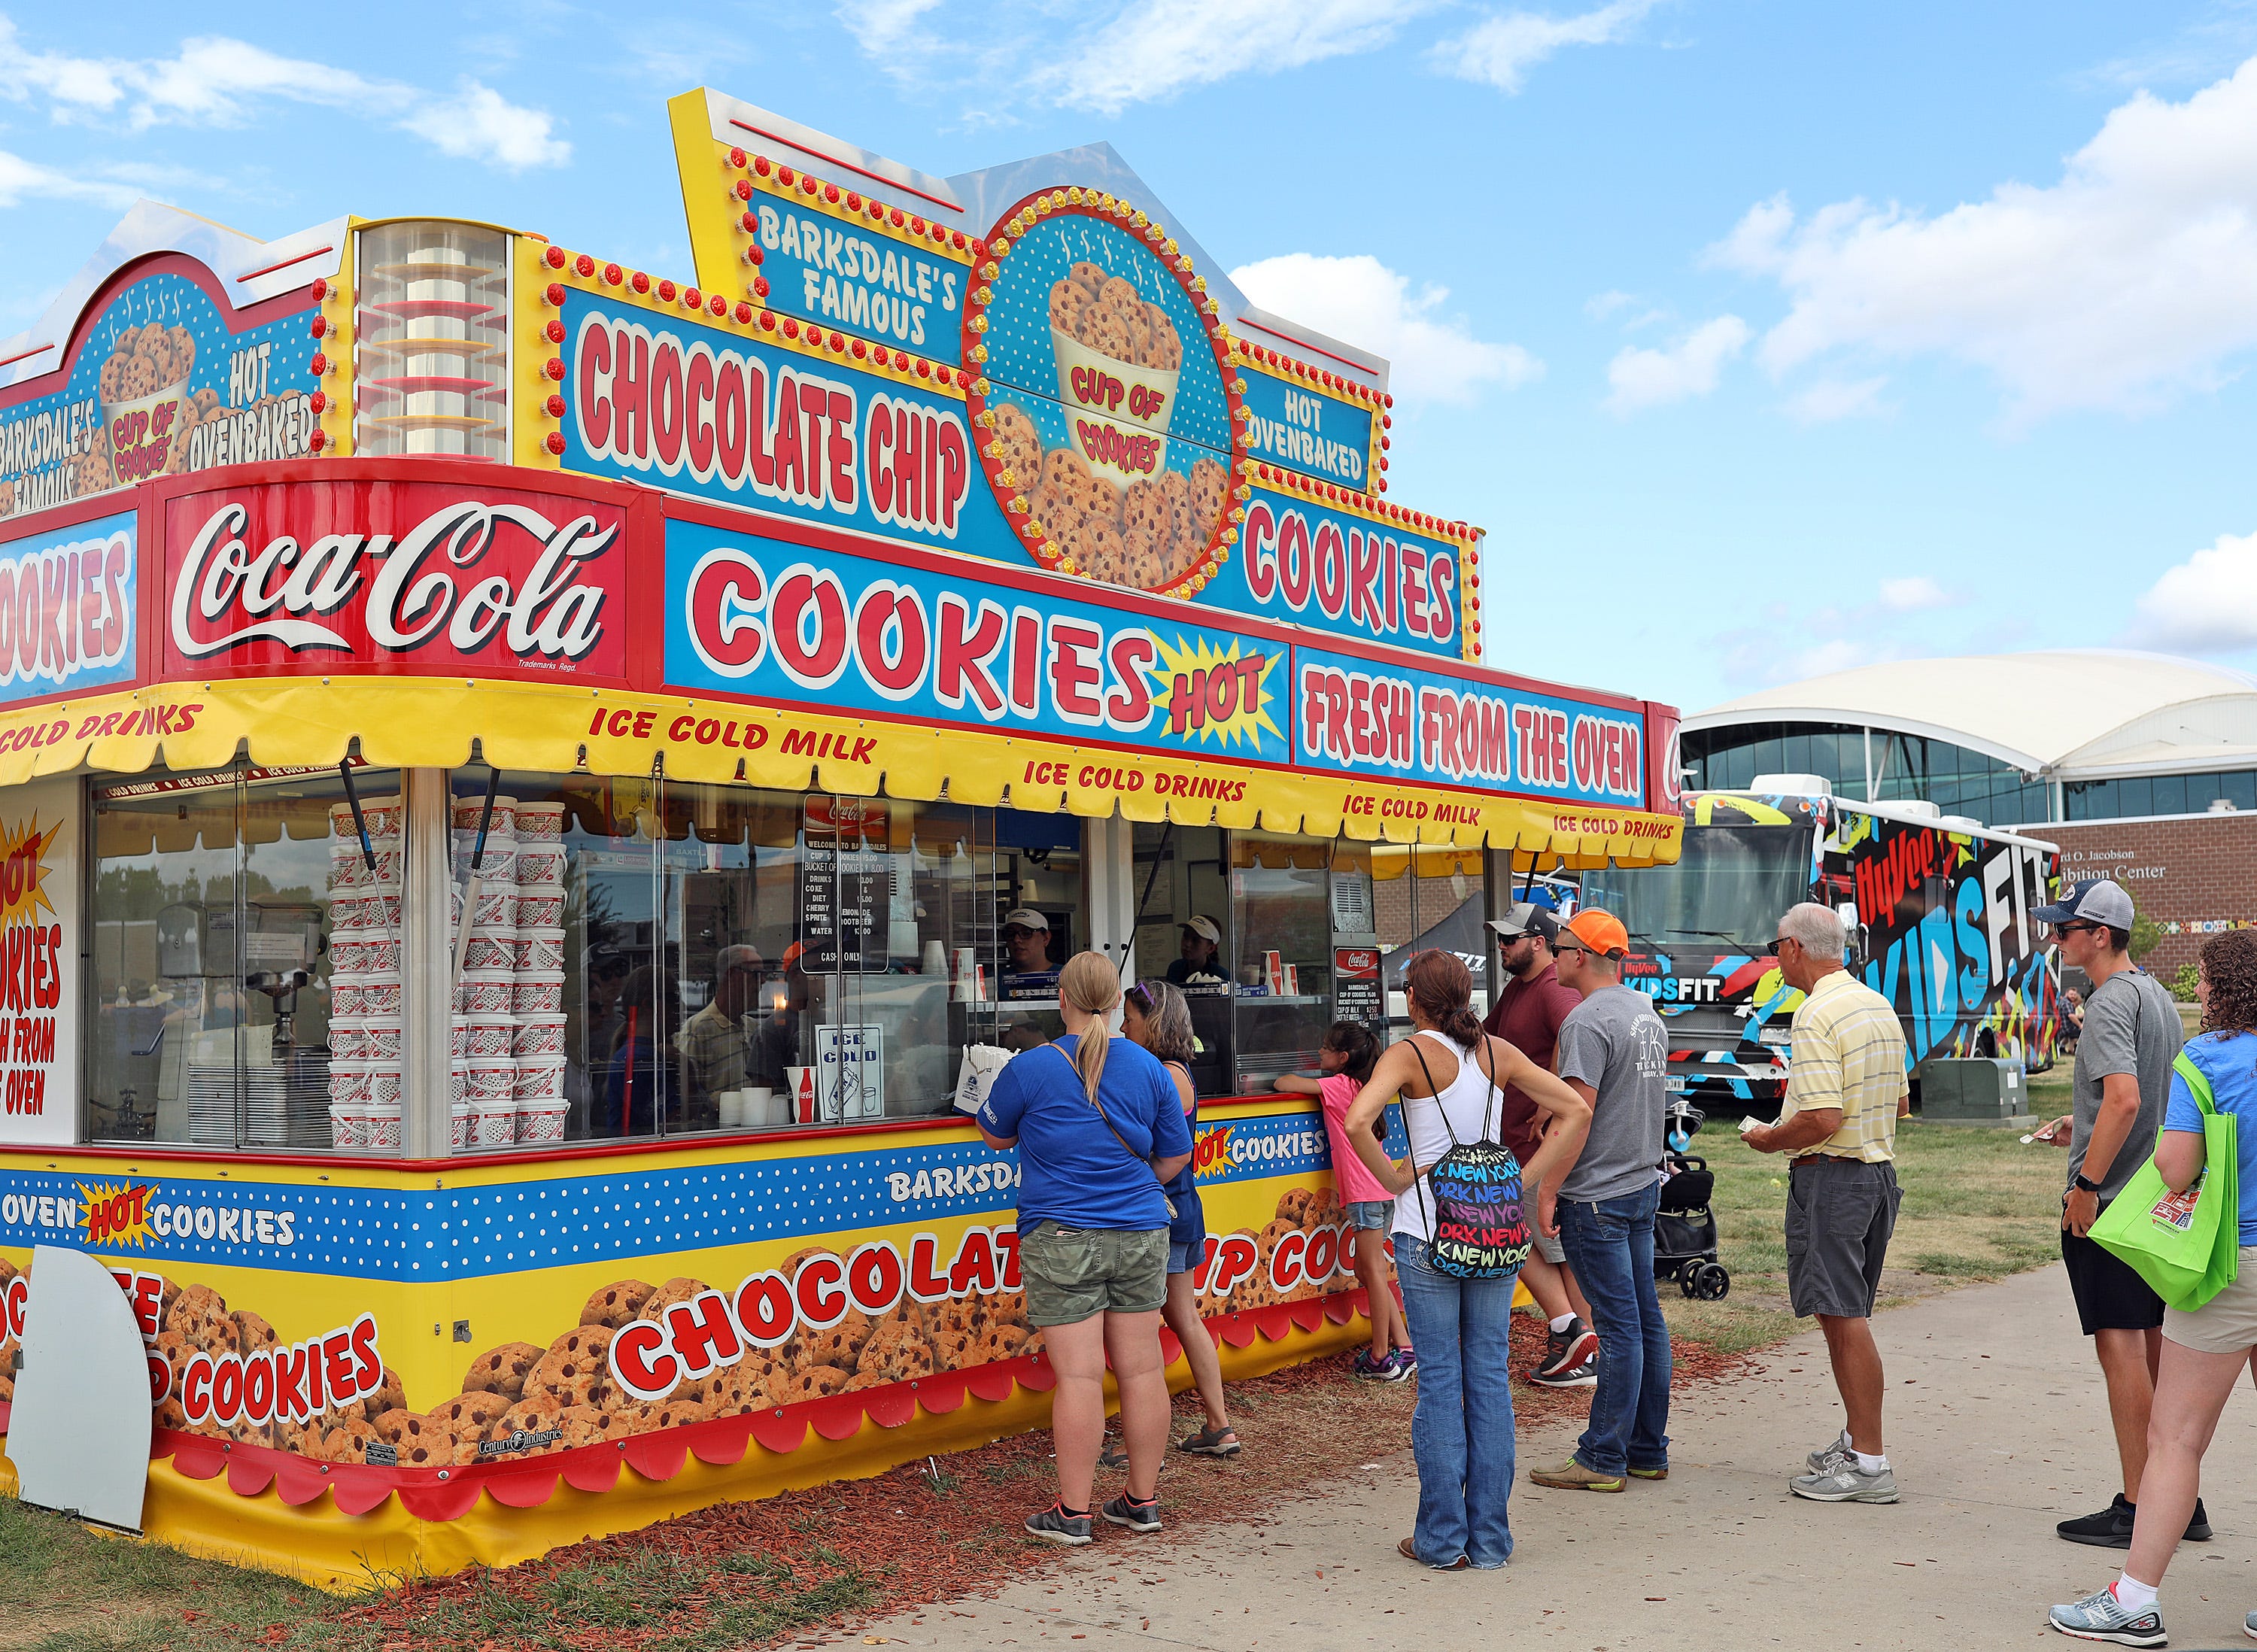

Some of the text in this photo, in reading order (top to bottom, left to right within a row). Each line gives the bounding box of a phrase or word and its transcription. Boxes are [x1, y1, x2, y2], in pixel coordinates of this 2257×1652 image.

[758, 205, 957, 311] BARKSDALE'S
[803, 268, 926, 345] FAMOUS
[229, 341, 272, 408] HOT
[1071, 366, 1166, 421] CUP OF
[1284, 388, 1323, 433] HOT
[112, 400, 178, 451] CUP OF
[190, 394, 314, 472] OVENBAKED
[575, 311, 971, 539] CHOCOLATE CHIP
[114, 434, 172, 483] COOKIES
[1076, 417, 1160, 475] COOKIES
[1248, 416, 1362, 481] OVENBAKED
[14, 463, 74, 515] FAMOUS
[172, 501, 618, 662] Coca-Cola
[1241, 498, 1456, 644] COOKIES
[0, 533, 130, 685] OOKIES
[686, 548, 1156, 733] COOKIES
[518, 659, 577, 673] Trademarks Regd.
[1169, 653, 1266, 736] HOT
[0, 703, 204, 752] COLD DRINKS
[589, 708, 878, 764] ICE COLD MILK
[1302, 664, 1414, 767] FRESH
[1418, 686, 1510, 782] FROM
[1512, 703, 1569, 788] THE
[1573, 714, 1641, 798] OVEN
[129, 782, 159, 796] DRINKS
[177, 778, 190, 788] ICE
[190, 774, 214, 787] COLD
[1024, 761, 1247, 803] ICE COLD DRINKS
[828, 802, 868, 821] Cca-Cola
[1342, 794, 1481, 827] ICE COLD MILK
[1553, 814, 1675, 840] ICE COLD DRINKS
[807, 840, 837, 849] WELCOME
[810, 852, 823, 860] CUP
[840, 853, 859, 861] OOKIES
[2073, 851, 2085, 862] O.
[2088, 849, 2134, 862] Jacobson
[804, 861, 828, 872] BUCKET
[828, 863, 837, 872] OF
[841, 863, 864, 873] OOKIES
[810, 875, 832, 883] DRINKS
[2062, 864, 2166, 882] ibition Center
[805, 885, 823, 893] COKE
[813, 894, 827, 903] DIET
[806, 904, 871, 916] CHERRY EMONDE
[811, 927, 833, 935] WATER
[821, 952, 861, 962] CASH ONLY
[1347, 952, 1369, 967] Coca-Cola
[1625, 962, 1657, 976] HyVee
[14, 1016, 56, 1066] FROM
[823, 1031, 877, 1063] ICE COLD
[5, 1069, 45, 1116] OVEN
[1232, 1130, 1326, 1164] COOKIES
[889, 1161, 1022, 1202] BARKSD
[1448, 1163, 1487, 1183] NEW
[1489, 1155, 1521, 1183] YORK
[1435, 1180, 1473, 1204] ORK
[1475, 1180, 1518, 1204] NEW
[2, 1183, 296, 1247] OVEN HOT COOKIES
[1449, 1201, 1495, 1225] NEW
[1496, 1201, 1525, 1224] YOR
[1439, 1222, 1480, 1246] ORK
[1481, 1222, 1521, 1247] NEW
[1433, 1254, 1472, 1278] ORK
[1475, 1262, 1516, 1278] NEW
[1452, 1244, 1496, 1267] NEW
[609, 1225, 1025, 1401] CHOCOLAT
[1194, 1233, 1259, 1296] IP
[181, 1311, 384, 1426] COOKIES
[478, 1428, 563, 1455] Century Industries
